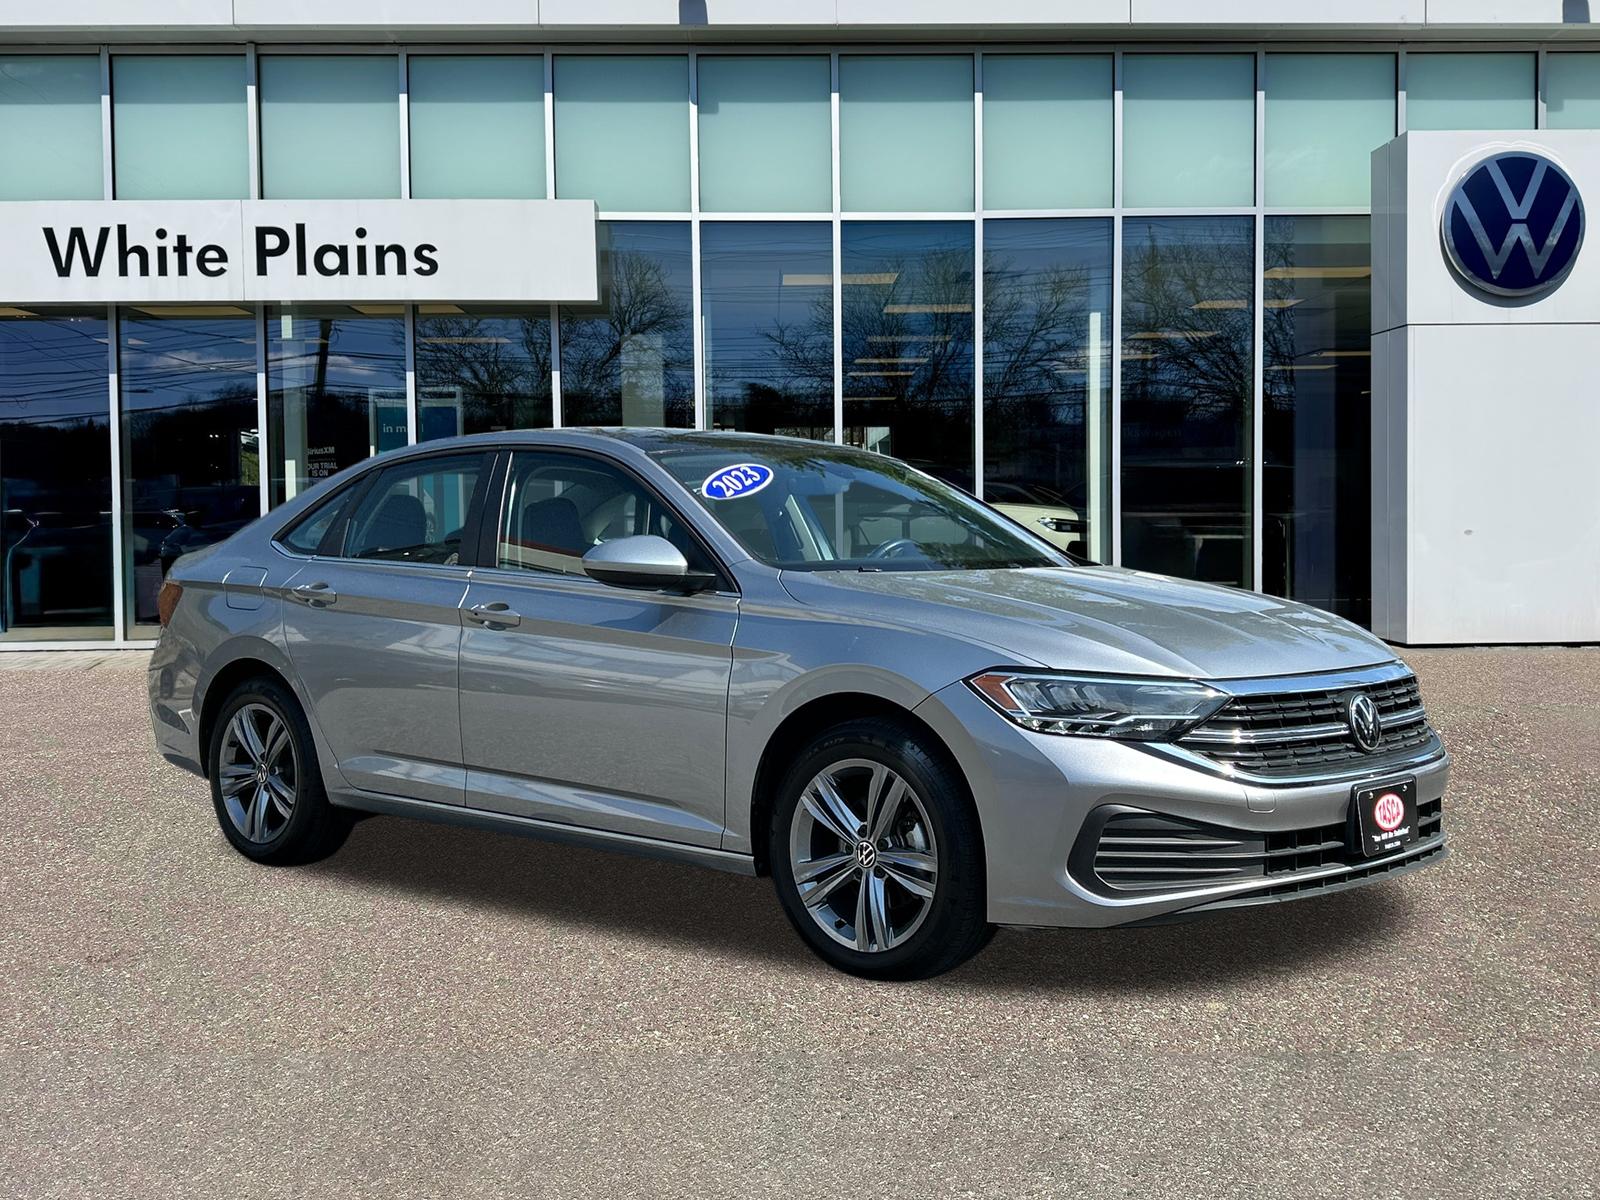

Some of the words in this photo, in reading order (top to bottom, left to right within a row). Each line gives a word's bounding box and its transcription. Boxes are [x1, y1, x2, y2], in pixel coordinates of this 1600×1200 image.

[1447, 155, 1581, 282] VW
[43, 224, 228, 277] White
[256, 223, 438, 277] Plains
[306, 462, 319, 470] OUR
[319, 469, 329, 477] ON
[712, 467, 760, 497] 2023
[1378, 798, 1401, 825] TASCA
